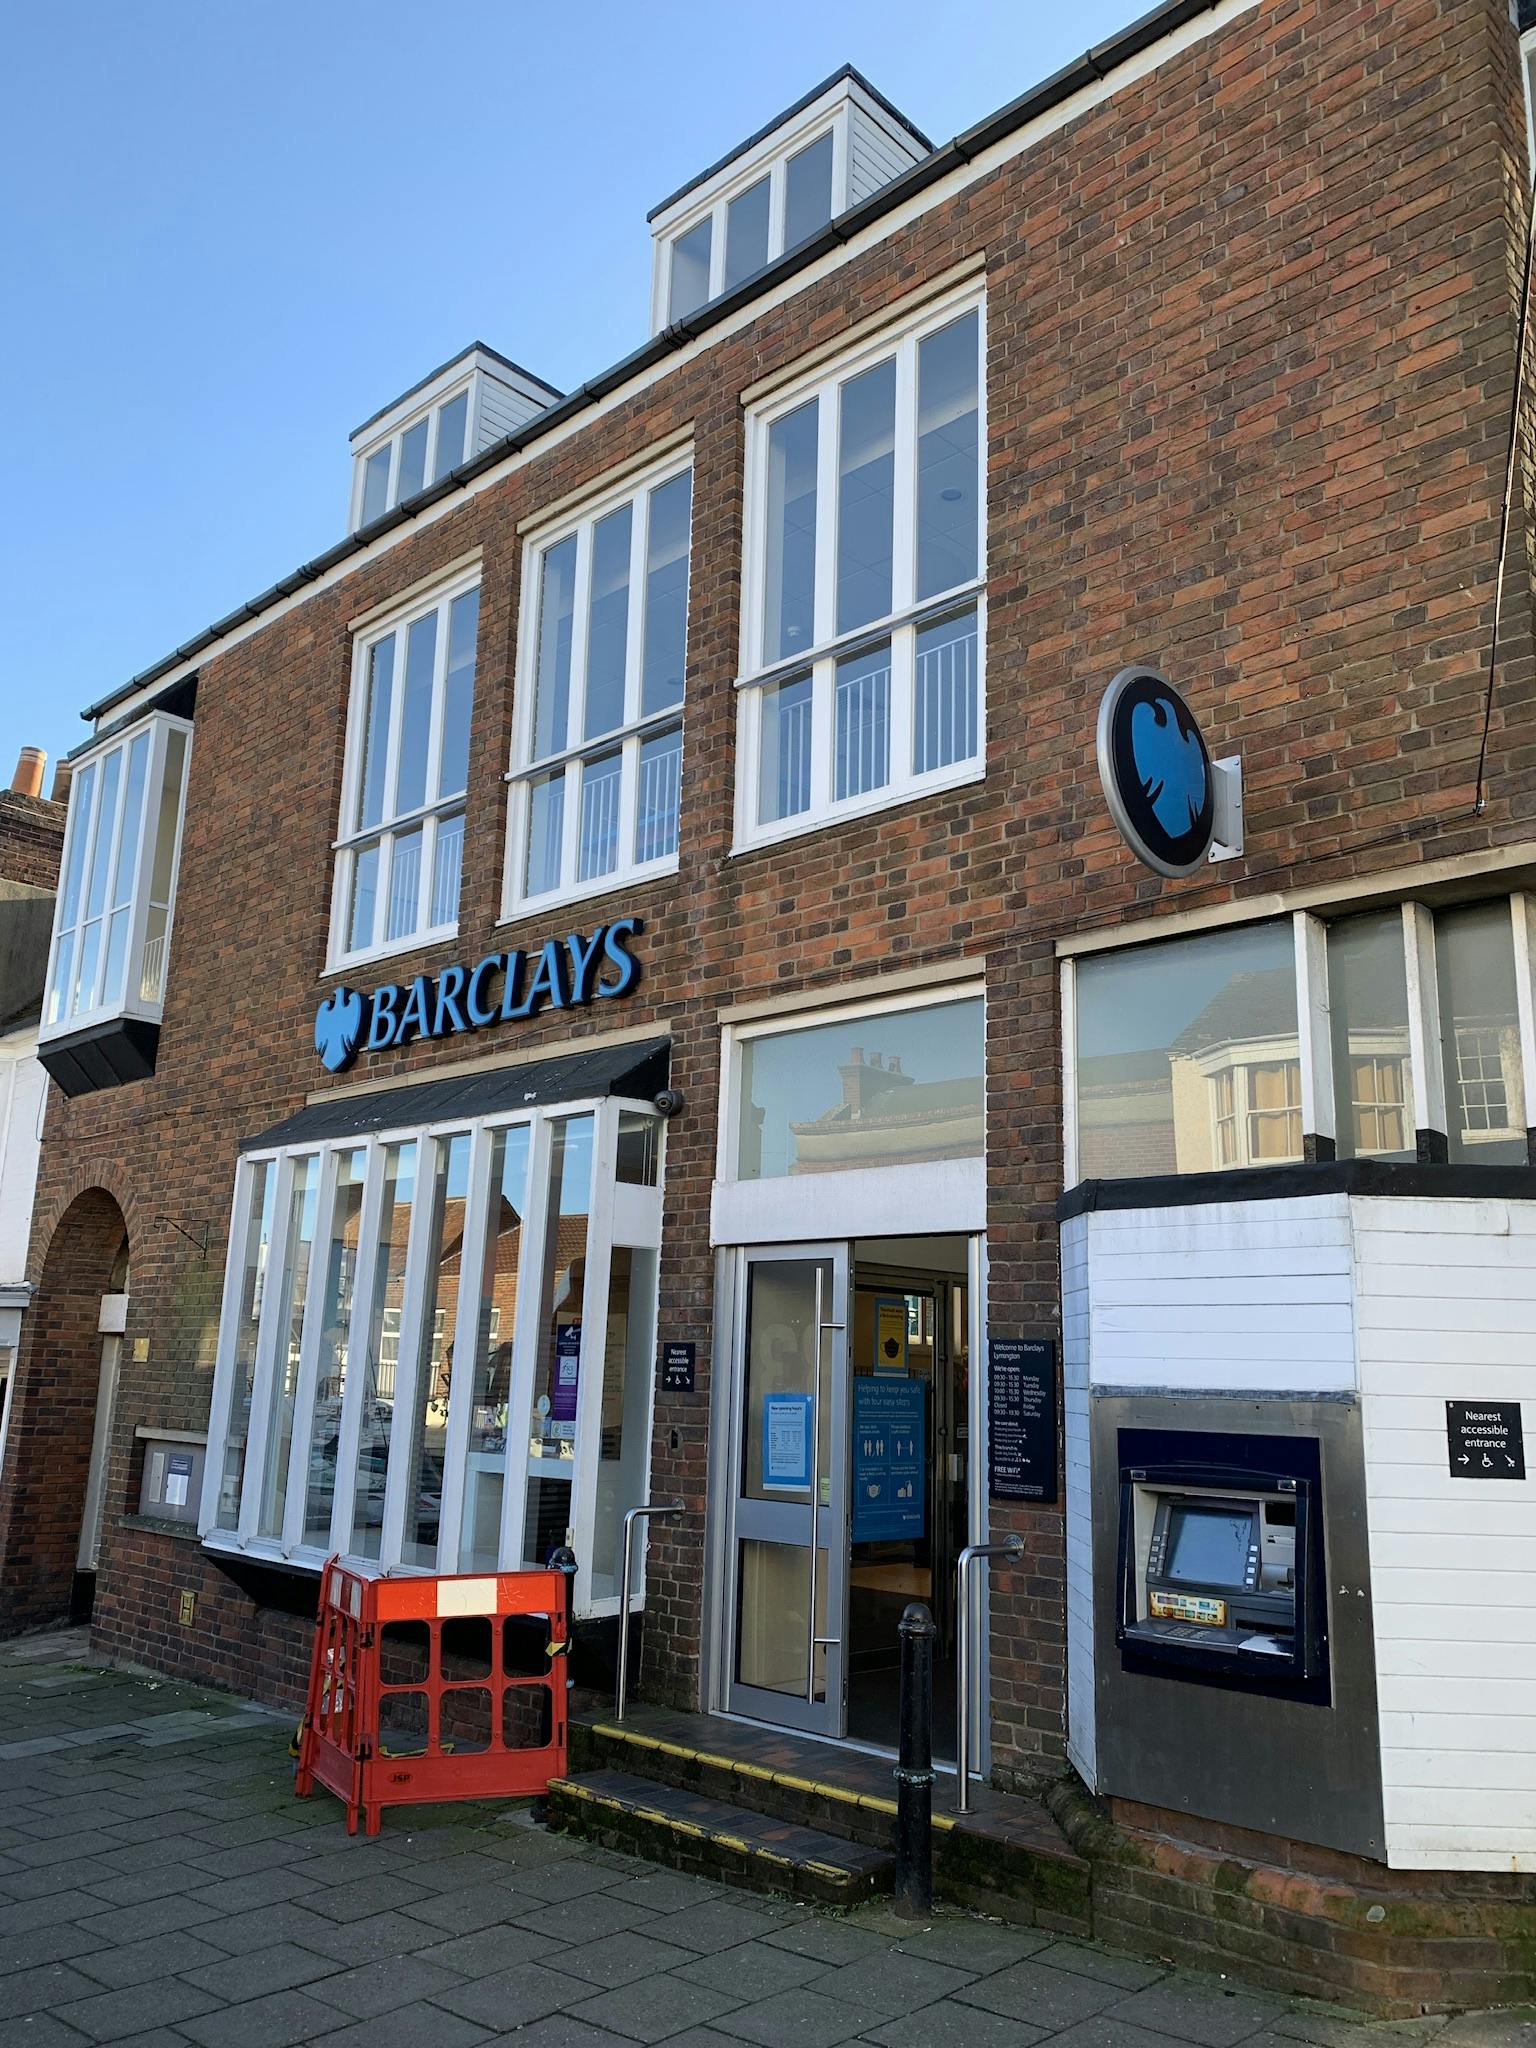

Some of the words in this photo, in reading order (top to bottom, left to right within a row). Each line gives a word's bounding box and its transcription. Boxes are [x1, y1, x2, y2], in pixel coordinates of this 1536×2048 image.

[368, 917, 645, 1051] BARCLAYS
[993, 1344, 1017, 1352] Welcome
[1018, 1344, 1023, 1352] to
[1024, 1344, 1045, 1353] Barclays
[993, 1352, 1021, 1360] Lymington
[1465, 1411, 1501, 1421] Nearest
[1460, 1425, 1509, 1435] accessible
[1464, 1439, 1507, 1448] entrance
